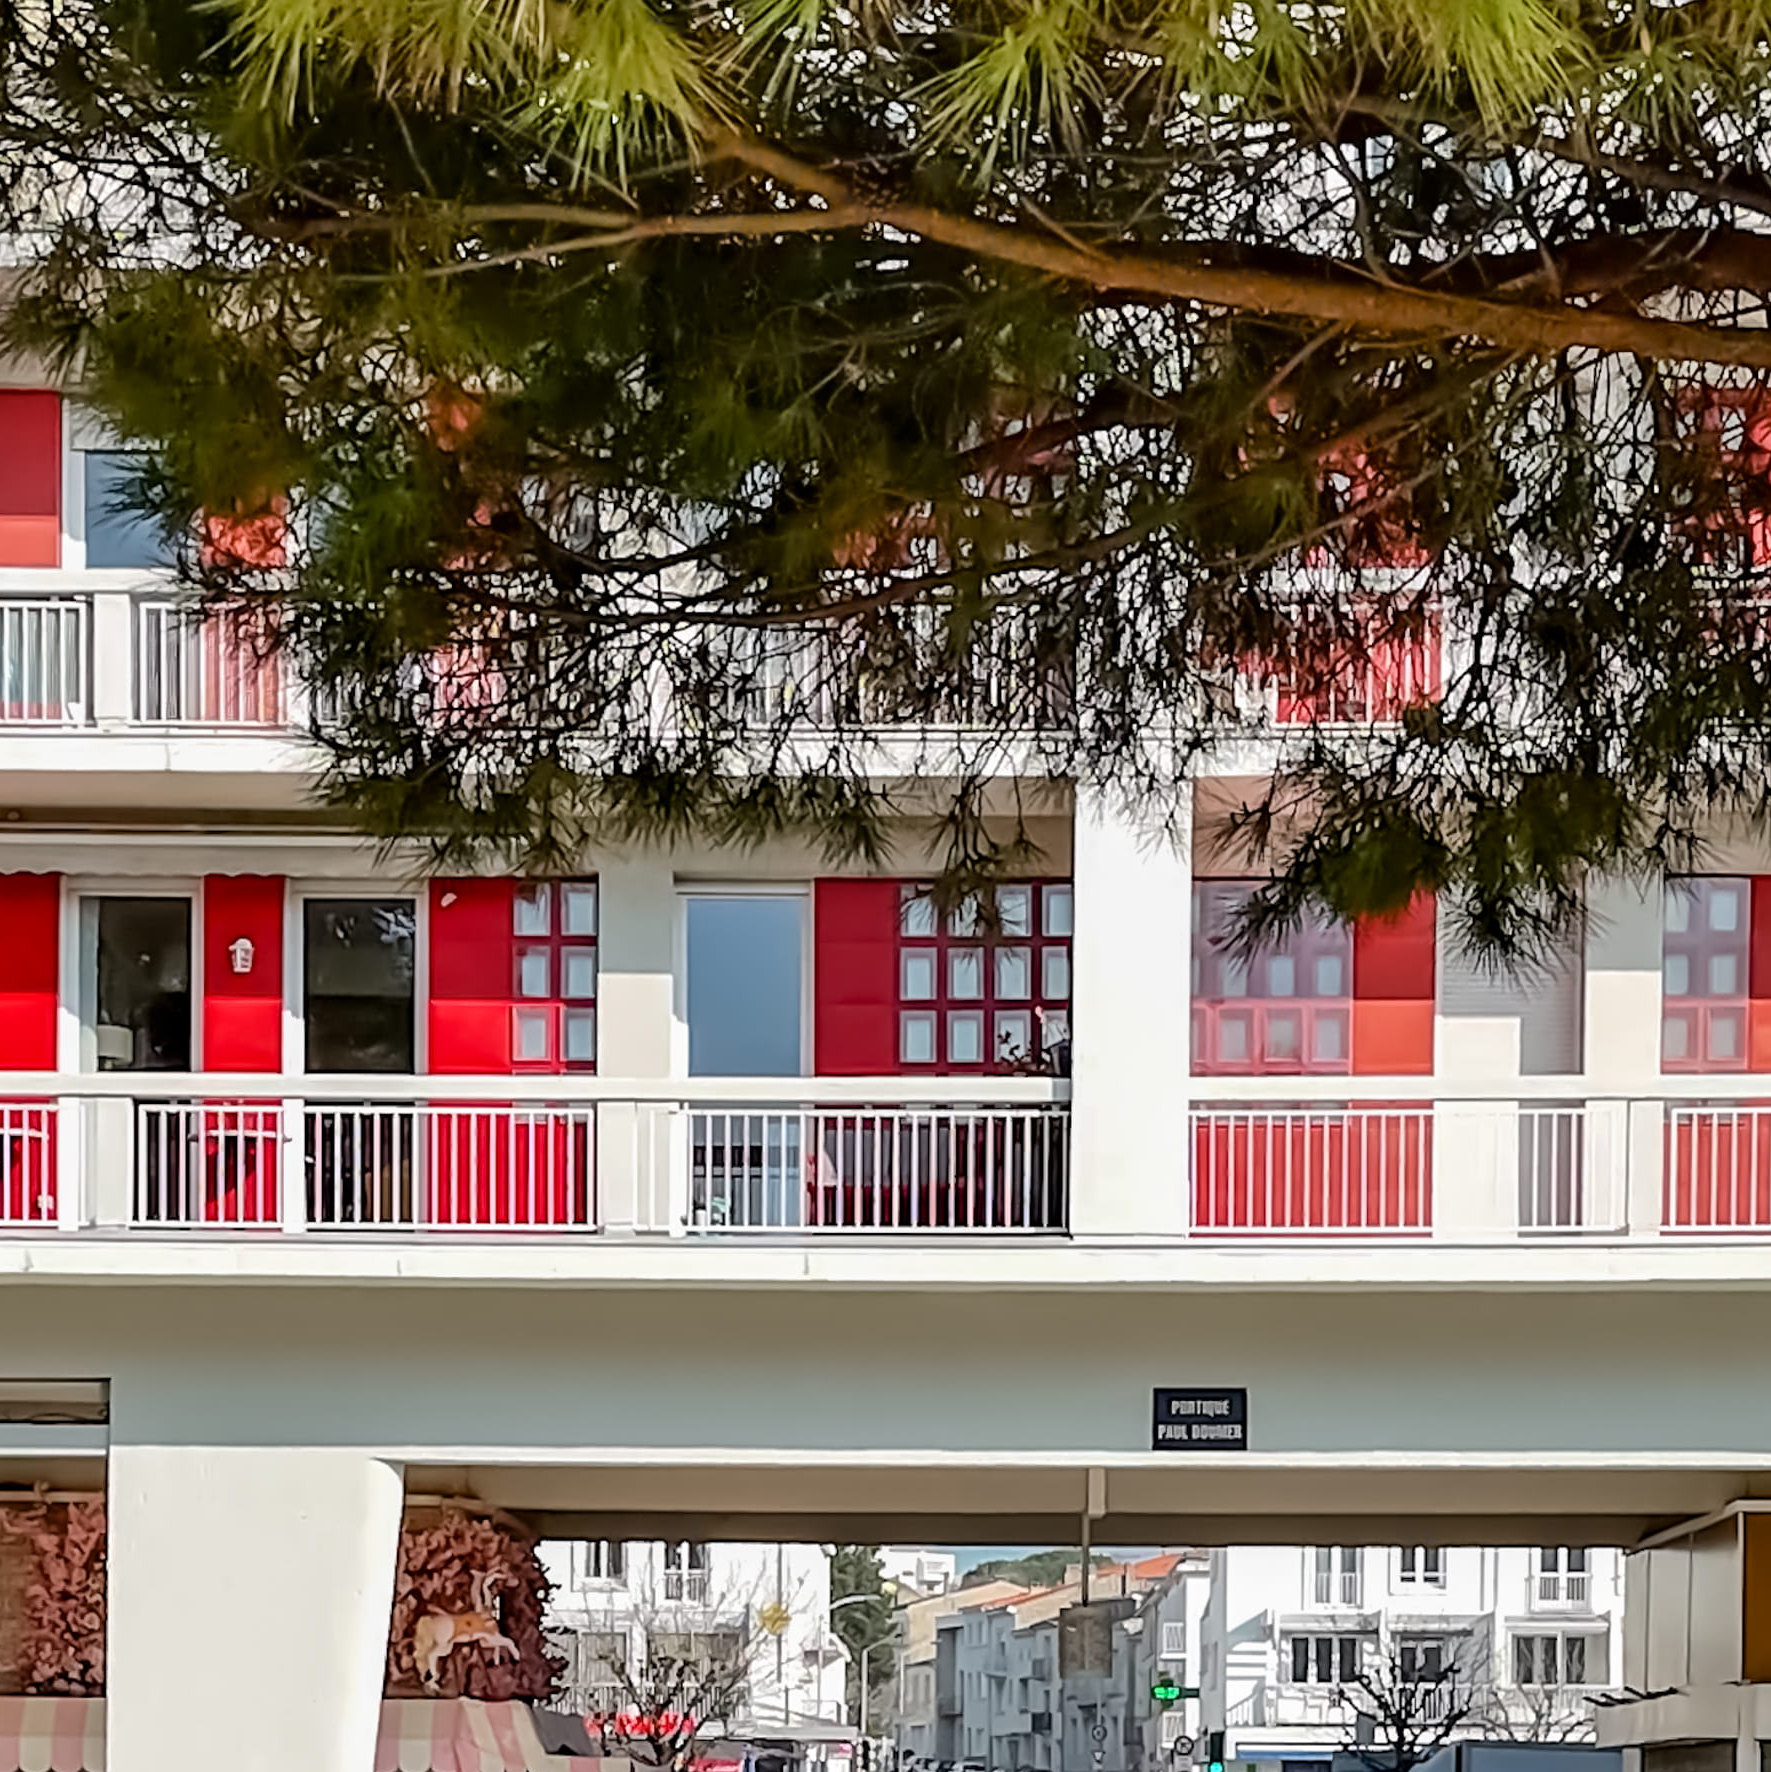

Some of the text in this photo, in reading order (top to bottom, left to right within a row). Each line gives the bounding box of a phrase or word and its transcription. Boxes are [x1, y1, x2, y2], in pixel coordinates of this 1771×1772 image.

[1171, 1400, 1230, 1417] PORTIQUE
[1158, 1424, 1242, 1440] PAUL DOUMER
